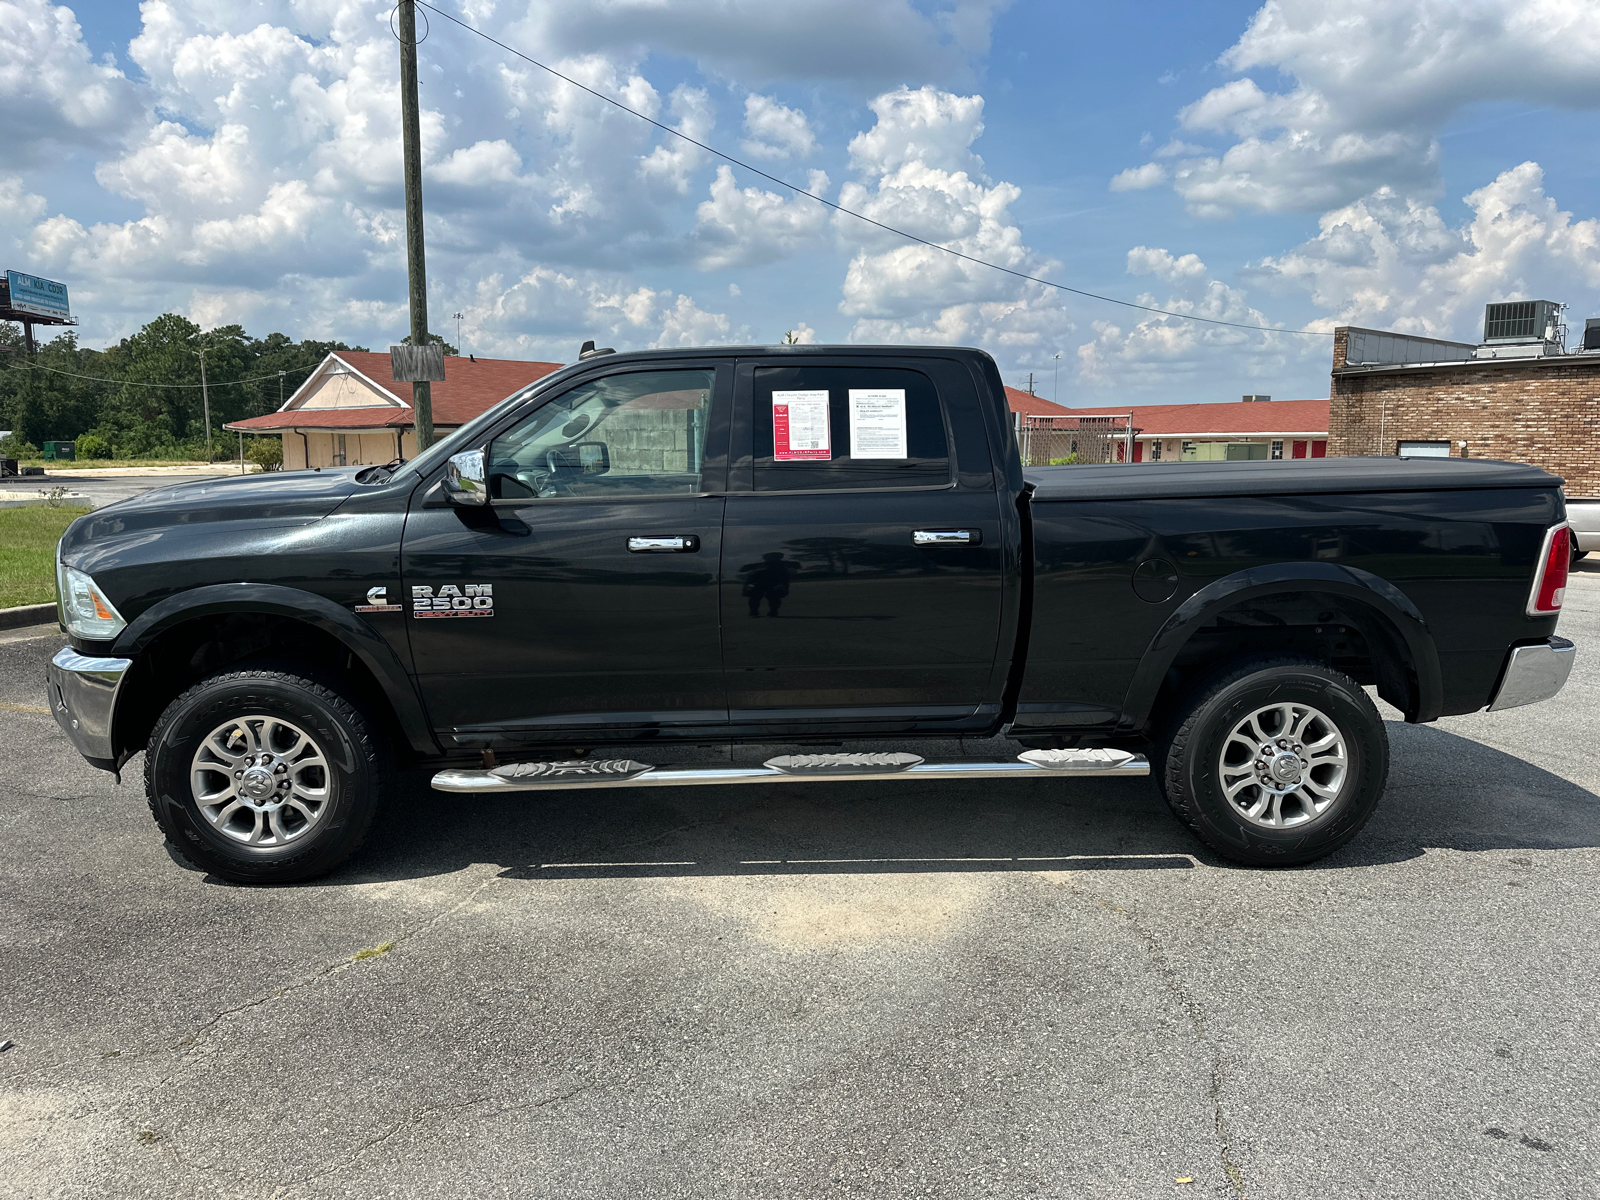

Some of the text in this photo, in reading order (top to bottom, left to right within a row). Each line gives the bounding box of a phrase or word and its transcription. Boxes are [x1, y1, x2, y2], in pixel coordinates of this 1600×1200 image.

[17, 276, 31, 287] ALM
[33, 280, 45, 290] KIA
[411, 584, 493, 598] RAM
[413, 596, 494, 610] 2500
[195, 695, 336, 741] GOODYEAR
[184, 828, 320, 870] WRANGLER
